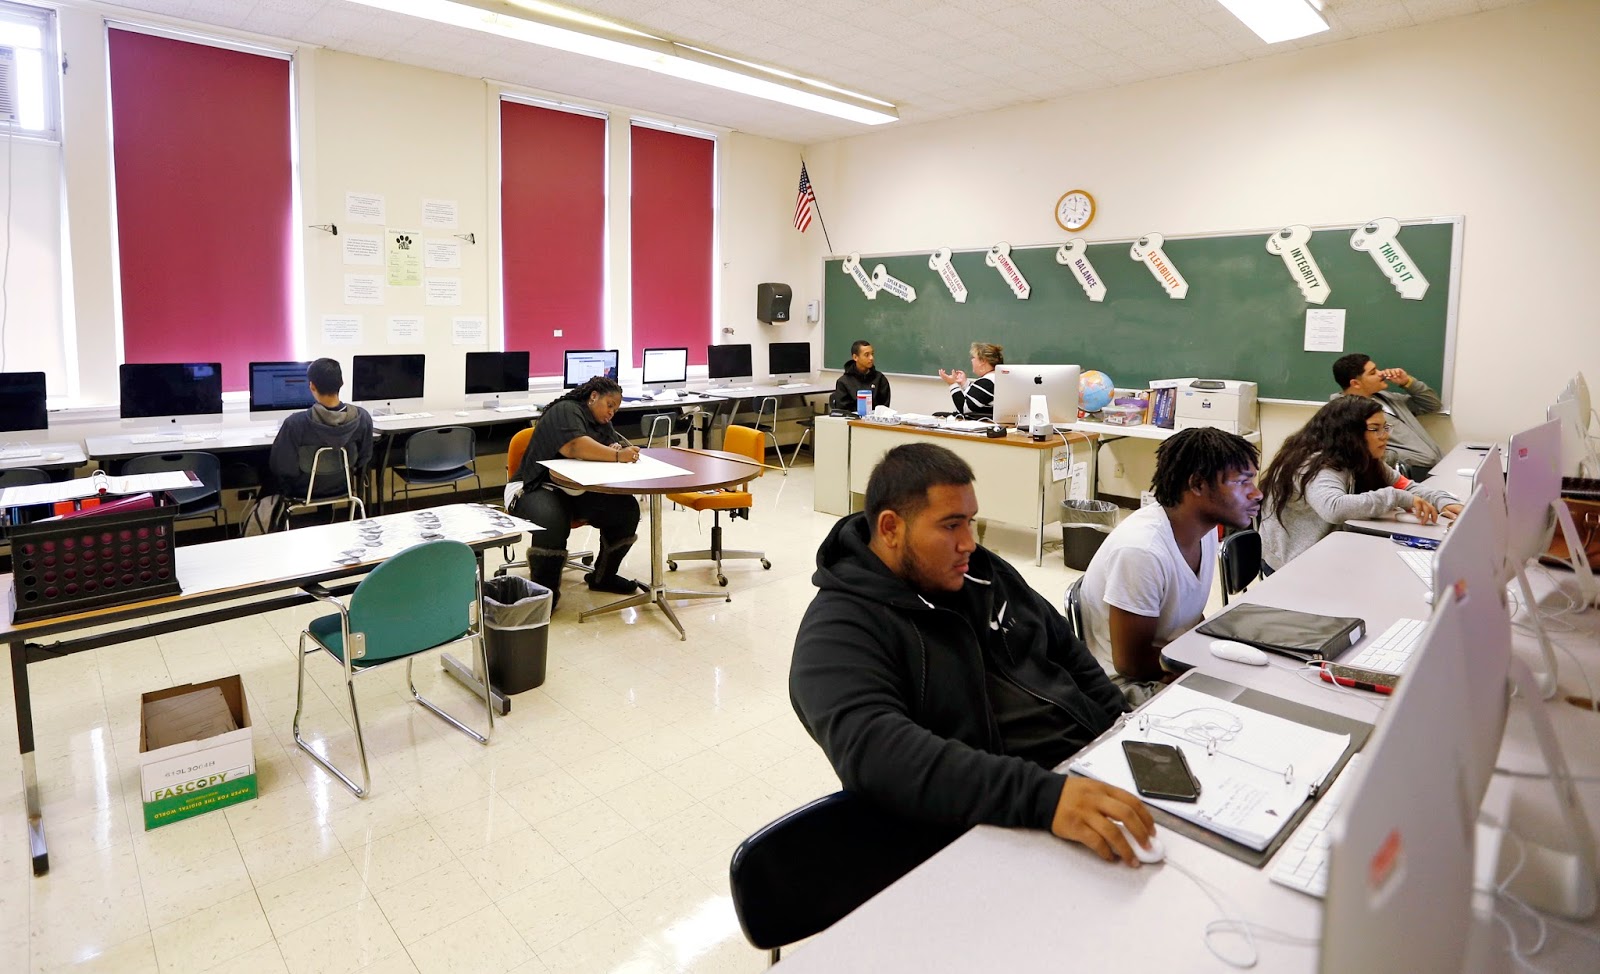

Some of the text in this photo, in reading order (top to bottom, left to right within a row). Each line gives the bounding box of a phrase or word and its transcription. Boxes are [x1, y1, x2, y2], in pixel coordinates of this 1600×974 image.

[944, 261, 964, 292] FAILURE LEADS
[997, 253, 1027, 294] COMMITMENT
[1074, 258, 1098, 289] BALANCE
[1147, 250, 1181, 290] FLEXIBILITY
[1290, 247, 1320, 289] INTEGRITY
[1378, 242, 1414, 282] THIS IS IT
[852, 265, 874, 293] OWNERSHIP
[945, 274, 958, 294] SUCCESS
[154, 772, 228, 801] FASCOPY
[231, 788, 249, 797] PAPER
[154, 809, 177, 819] WORLD
[178, 801, 202, 812] DIGITAL
